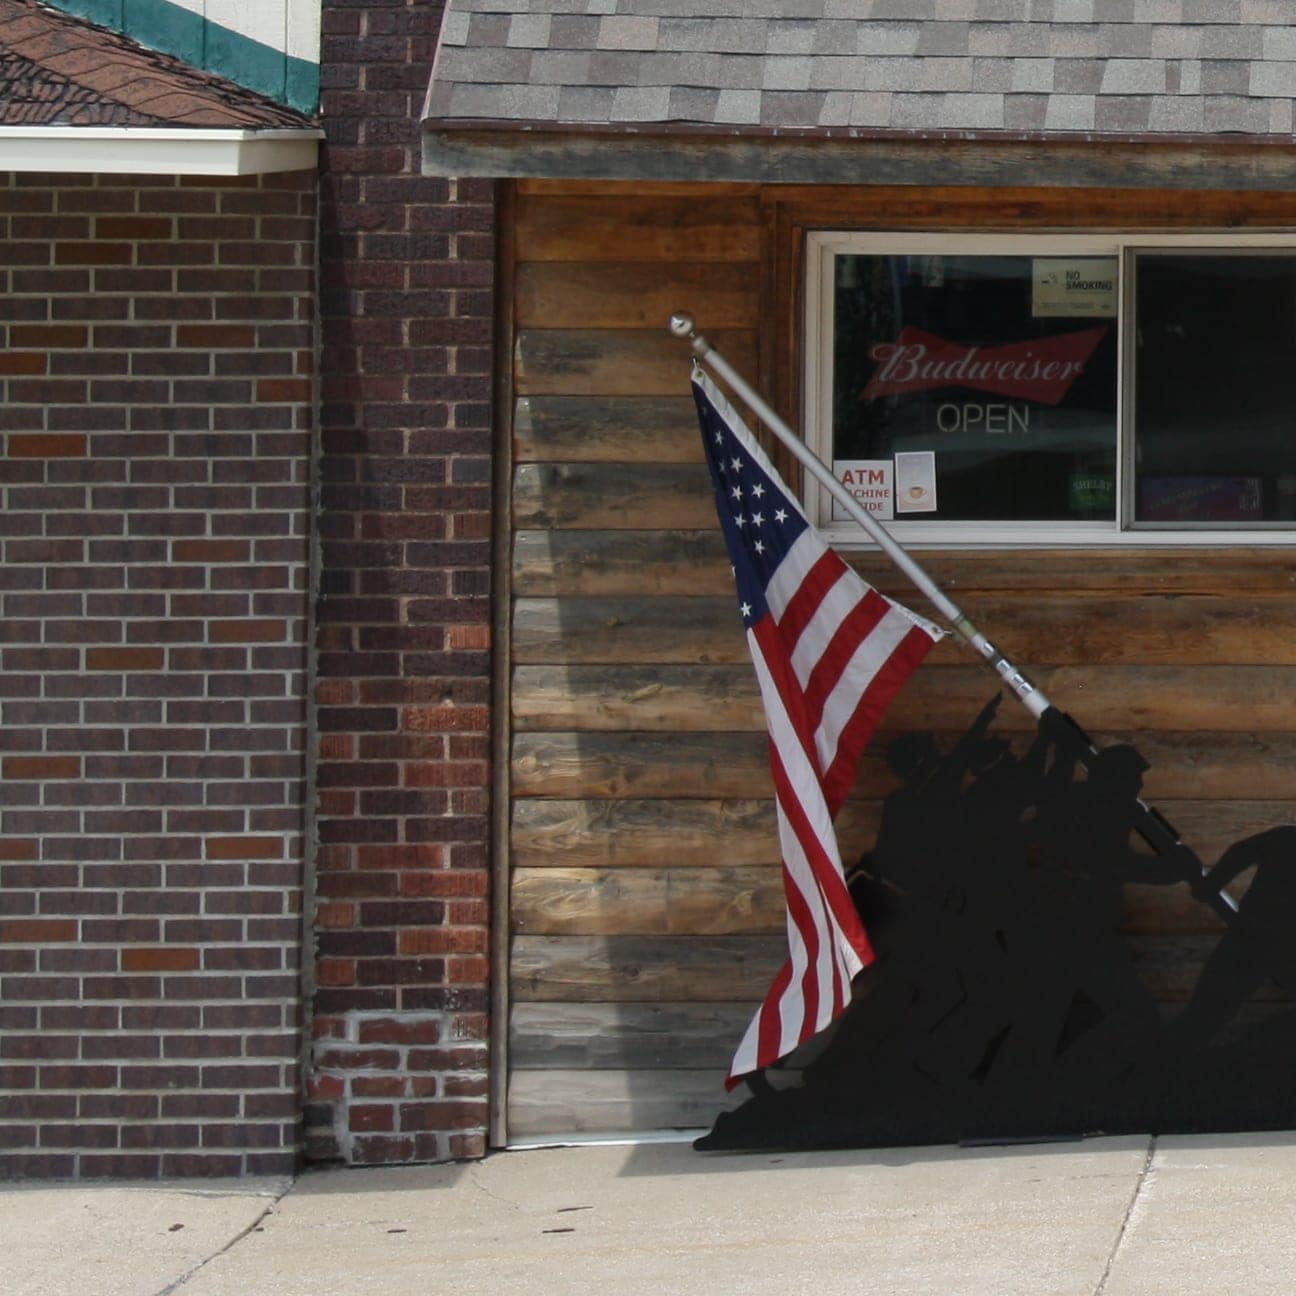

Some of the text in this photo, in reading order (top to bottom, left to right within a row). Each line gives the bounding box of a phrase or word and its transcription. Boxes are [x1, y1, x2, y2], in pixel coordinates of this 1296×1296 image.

[1064, 270, 1081, 281] NO
[1064, 280, 1113, 292] SMOKING
[869, 342, 1085, 383] Budweiser
[935, 403, 1031, 434] OPEN
[841, 469, 885, 485] ATM
[849, 489, 889, 498] CHINE
